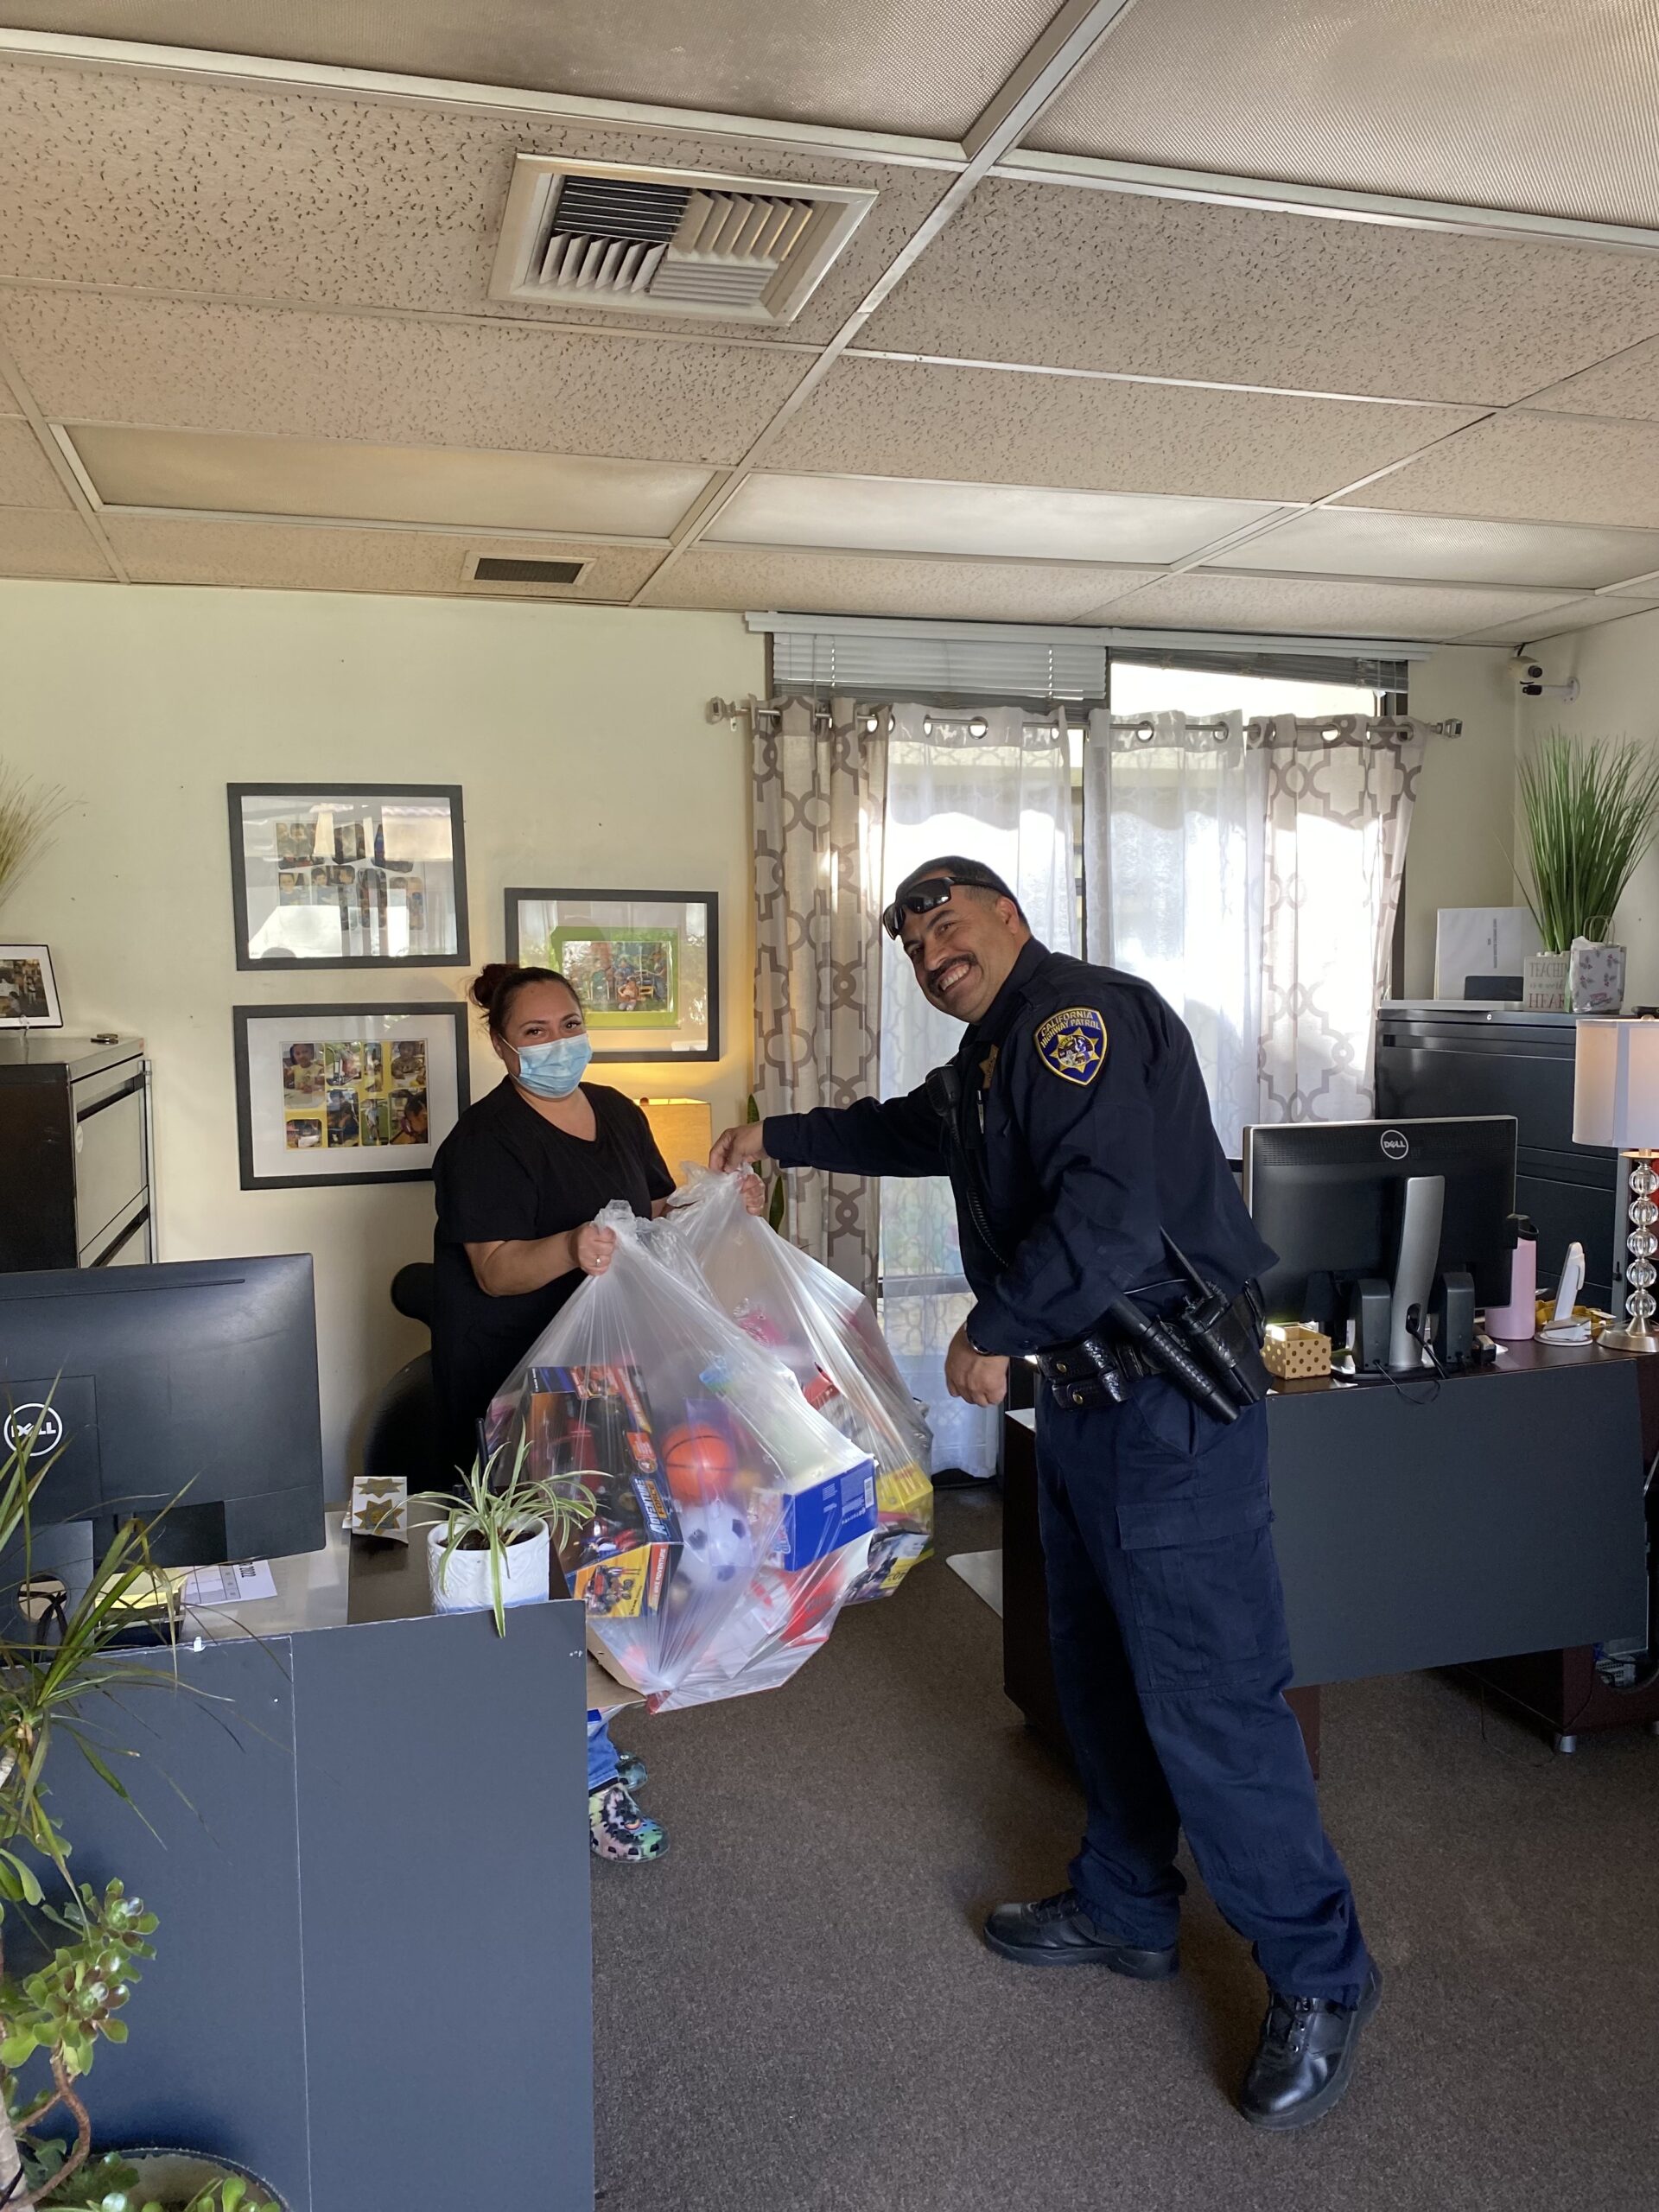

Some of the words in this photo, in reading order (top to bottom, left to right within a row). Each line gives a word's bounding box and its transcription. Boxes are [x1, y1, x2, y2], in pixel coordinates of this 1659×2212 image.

[1040, 1020, 1069, 1049] HIGHWAY
[1070, 1019, 1101, 1031] PATROL
[1041, 1011, 1094, 1037] CALIFORNIA
[1383, 1140, 1407, 1148] DELL
[634, 1478, 668, 1535] ADVENTURE
